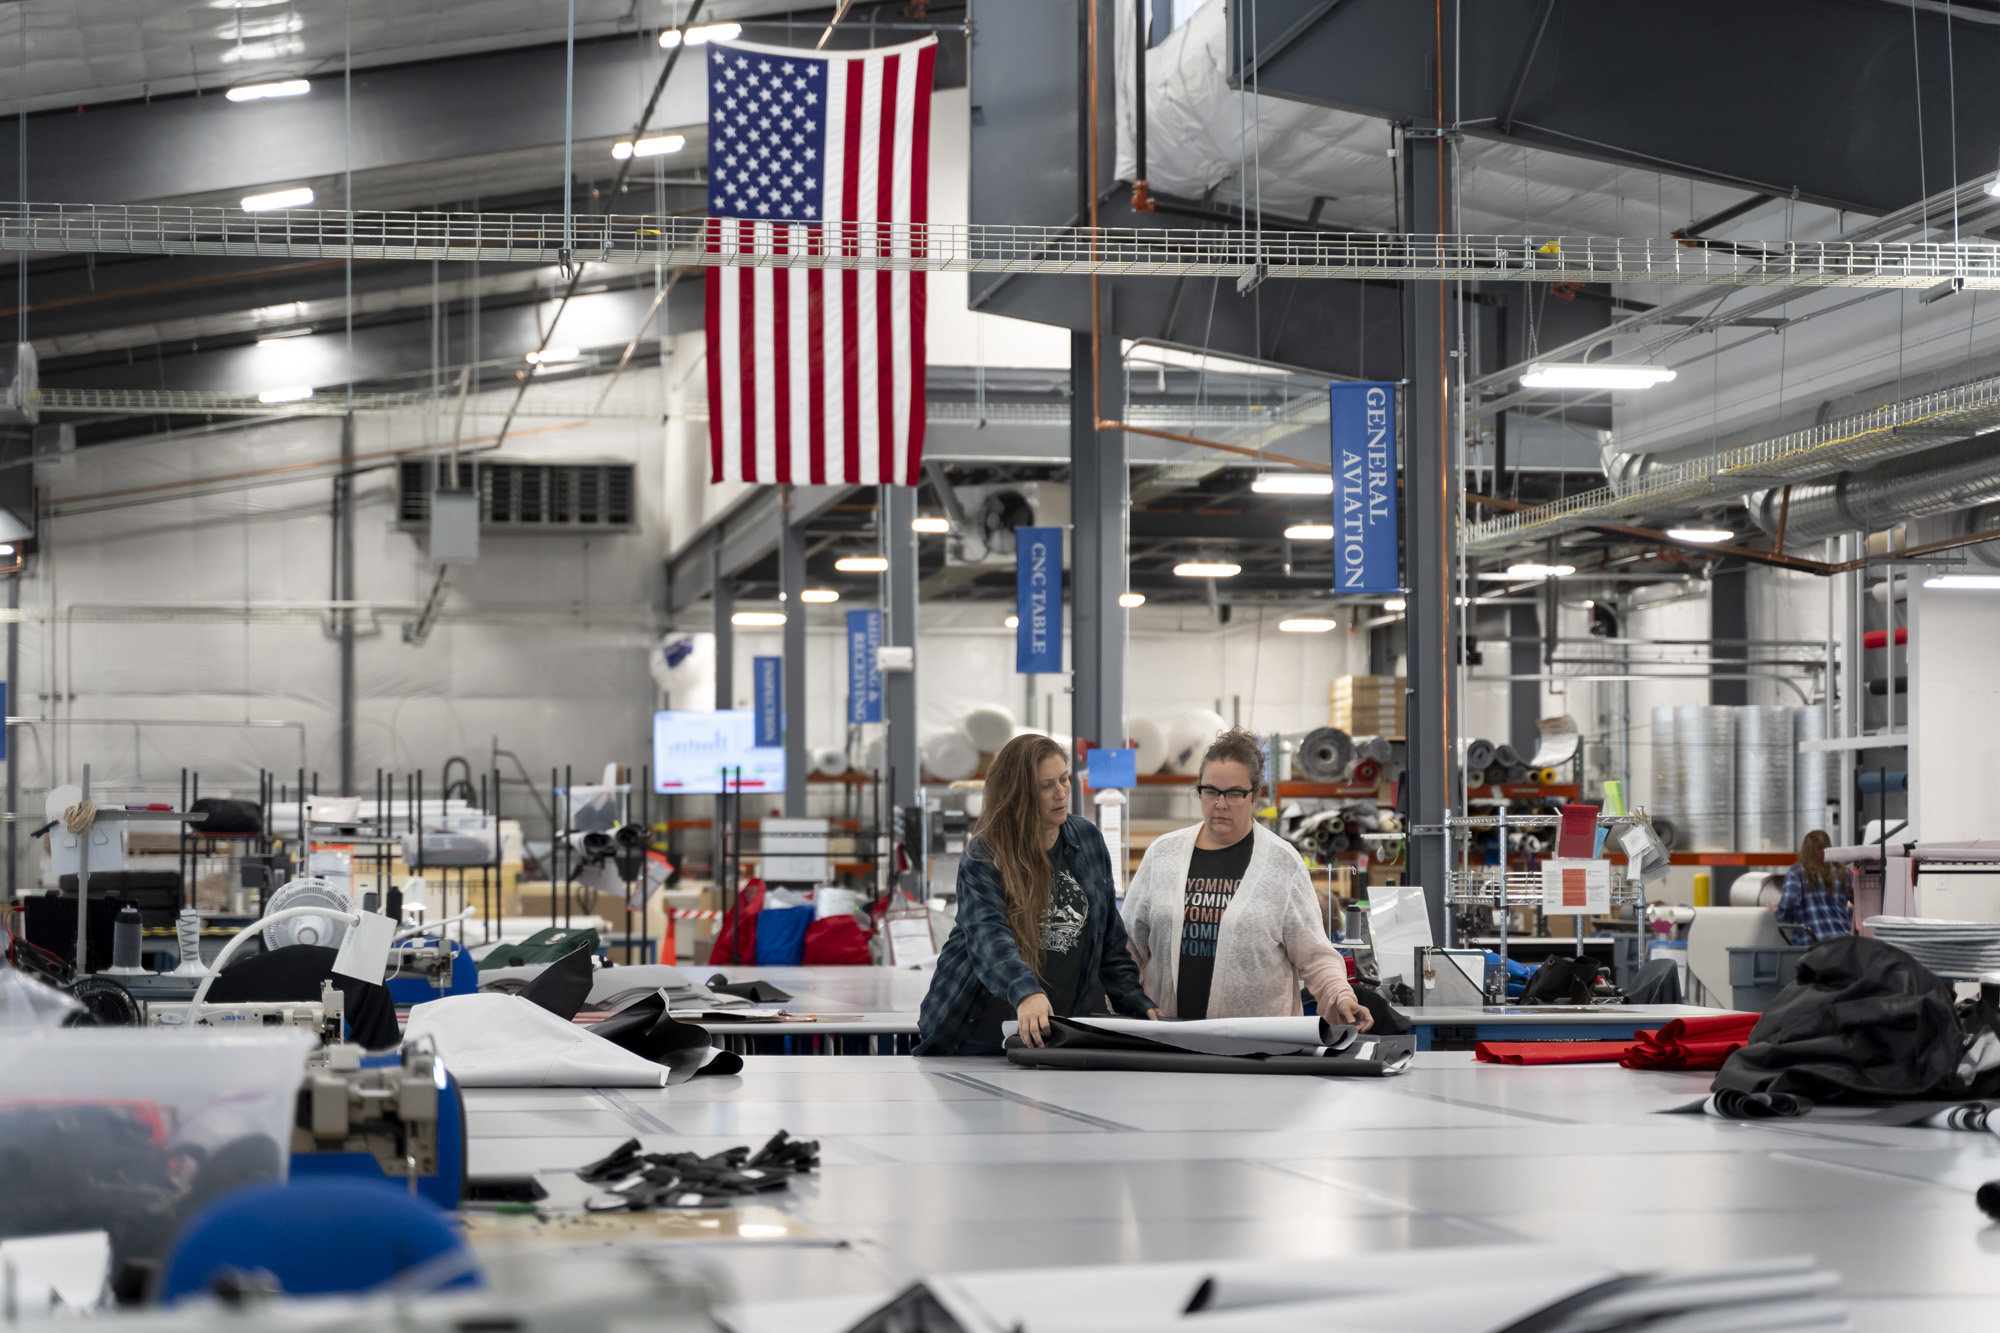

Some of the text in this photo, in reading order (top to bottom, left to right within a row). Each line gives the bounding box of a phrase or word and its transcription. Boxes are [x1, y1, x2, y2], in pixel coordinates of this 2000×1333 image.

[1342, 449, 1364, 588] AVIATION
[1366, 387, 1388, 525] GENERAL
[1032, 543, 1046, 654] CNC TABLE
